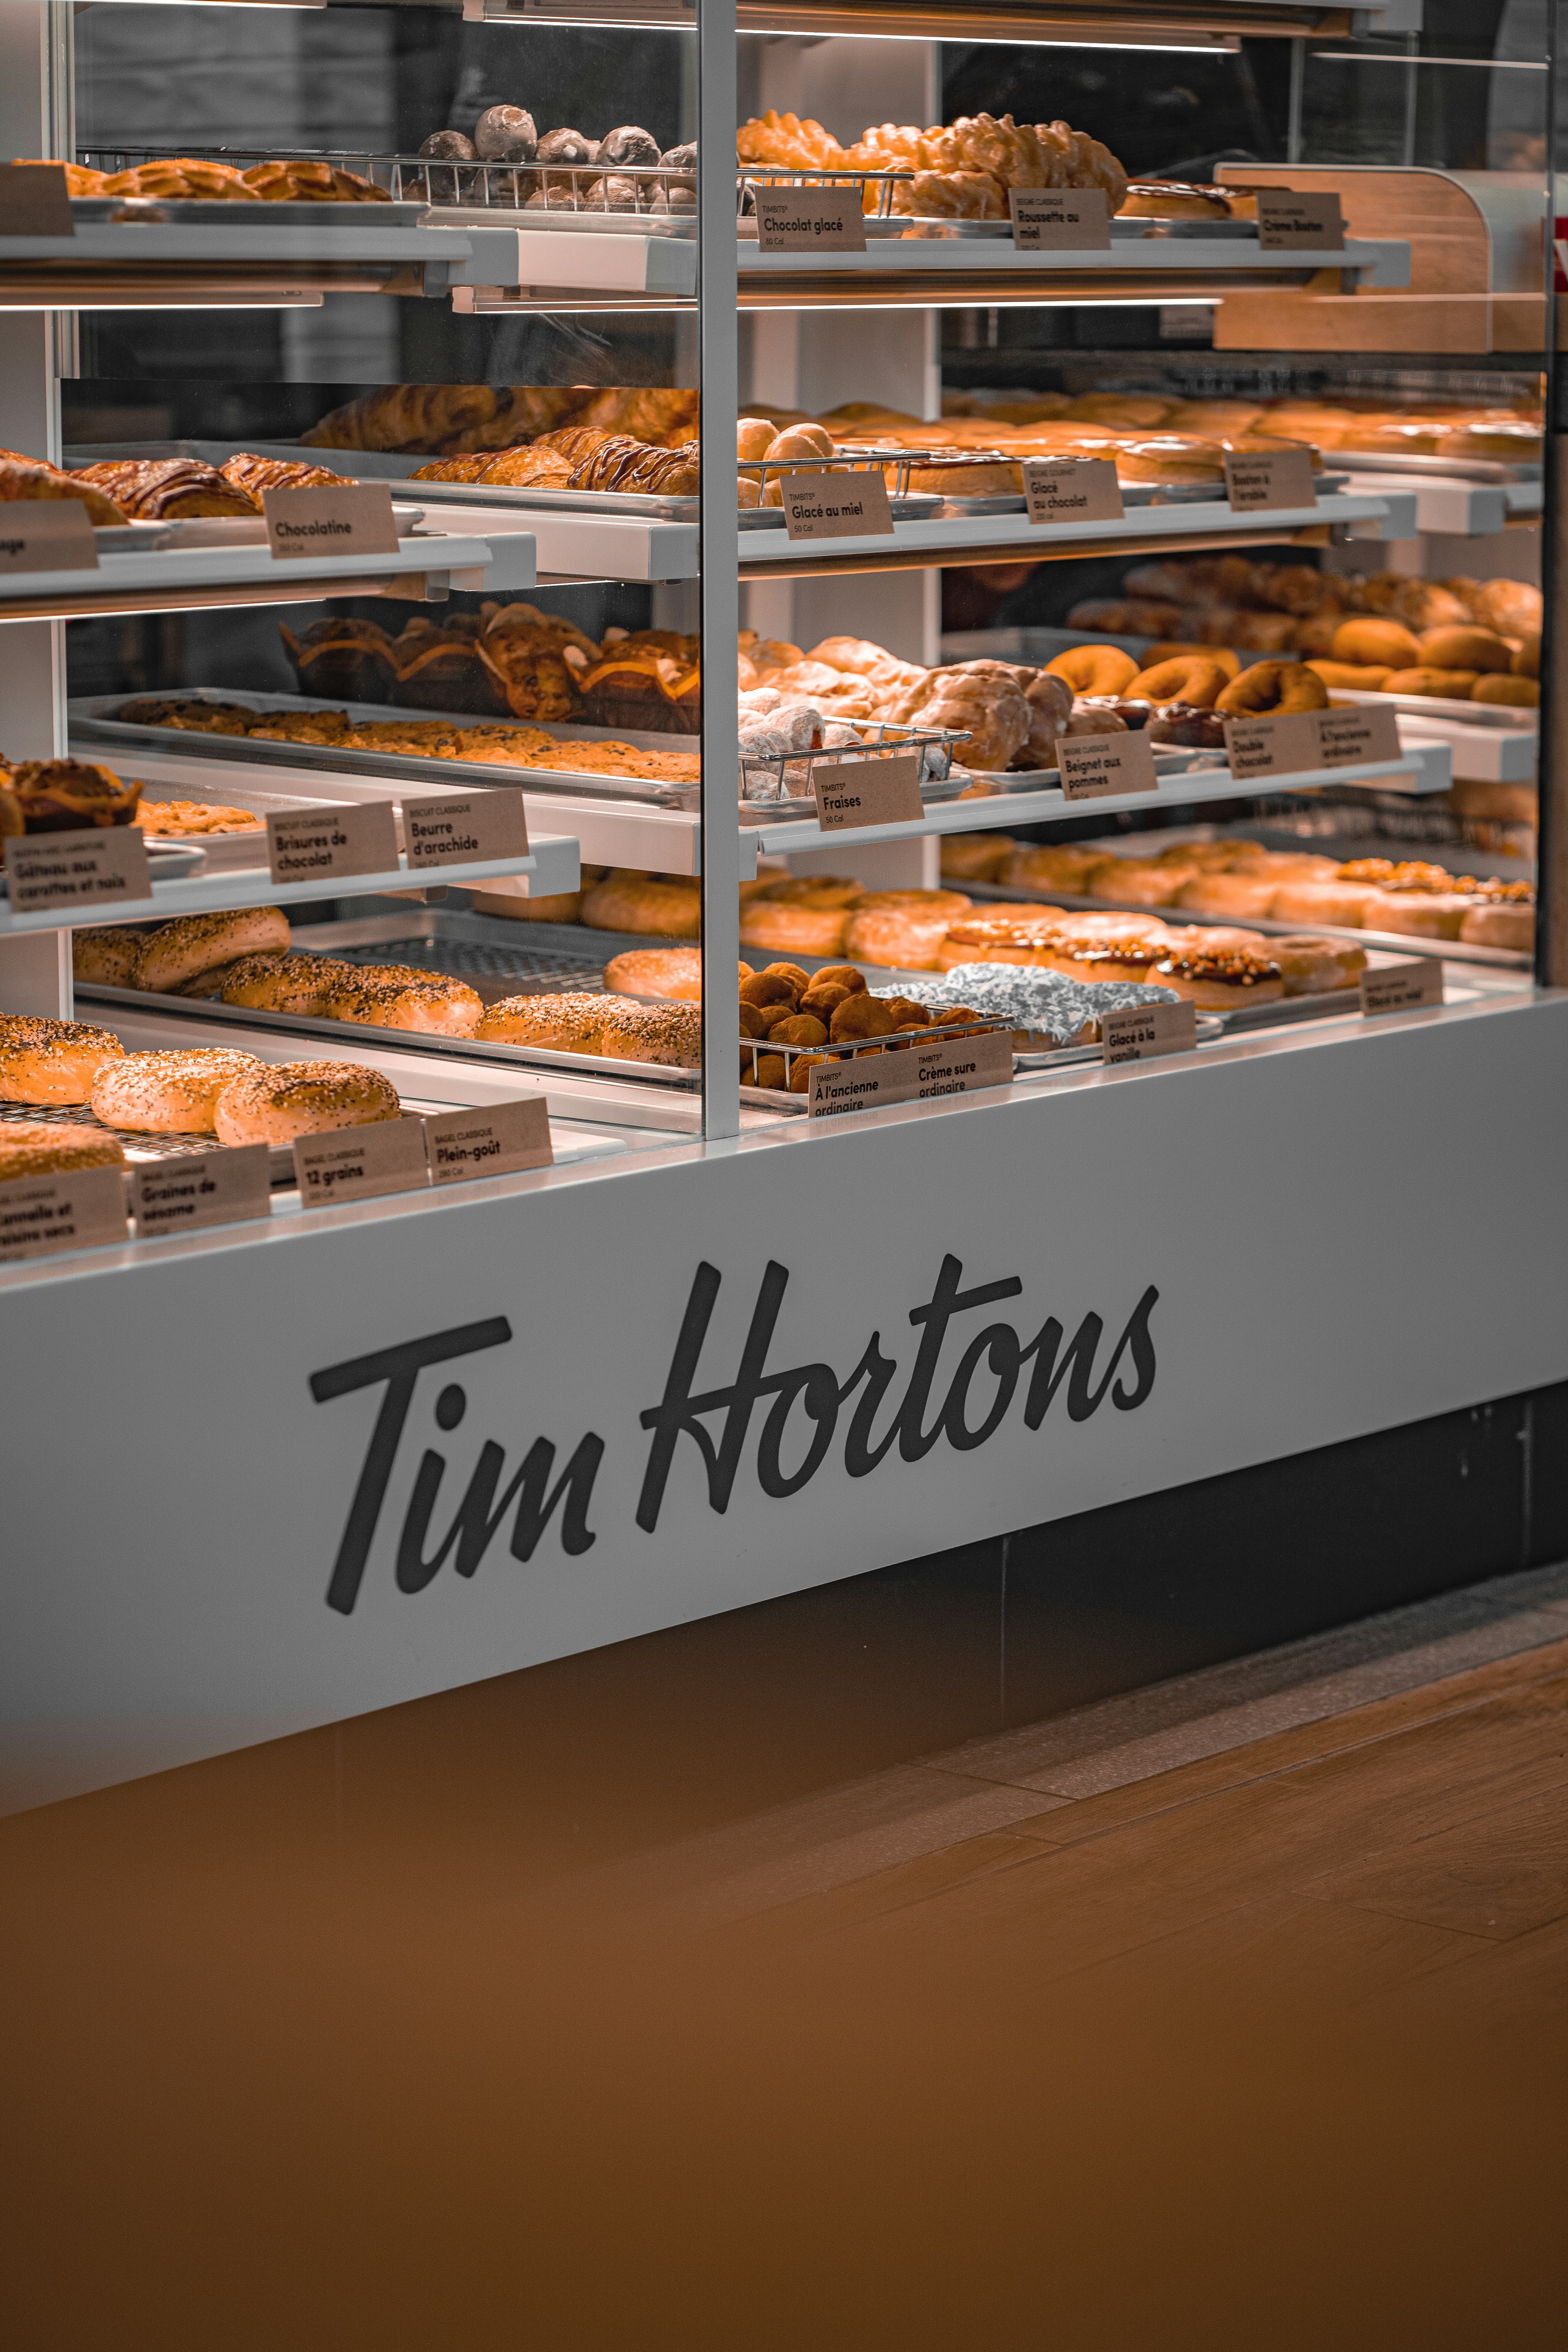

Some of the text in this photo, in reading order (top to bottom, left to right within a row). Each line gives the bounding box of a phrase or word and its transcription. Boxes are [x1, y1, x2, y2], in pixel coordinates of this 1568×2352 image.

[1018, 210, 1079, 222] Roussette au
[764, 218, 843, 235] Chocolat glacé
[1020, 226, 1040, 239] miel
[1031, 481, 1058, 494] Glacé
[1033, 494, 1088, 509] au chocolat
[792, 502, 864, 519] Glacé au miel
[276, 520, 352, 537] Chocolatine
[1234, 740, 1264, 753] Double
[1065, 758, 1122, 775] Beignet aux
[1236, 753, 1273, 768] chocolat
[1069, 776, 1108, 793] pommes
[824, 795, 861, 810] Fraises
[834, 814, 844, 822] Cal
[412, 823, 452, 837] Beurre
[276, 829, 347, 851] Brisures de
[414, 835, 478, 855] d'arachide
[278, 851, 332, 871] chocolat
[80, 877, 94, 892] et
[1109, 1028, 1155, 1047] Glacé à la
[1110, 1047, 1140, 1063] vanille
[919, 1063, 976, 1081] Crème sure
[815, 1081, 878, 1101] À l'ancienne
[919, 1079, 965, 1098] ordinaire
[815, 1098, 863, 1116] ordinaire
[437, 1140, 500, 1163] Plein-goût
[307, 1163, 363, 1187] 12 grains
[142, 1178, 215, 1202] Graines de
[307, 1252, 1160, 1617] Tim Hortons
